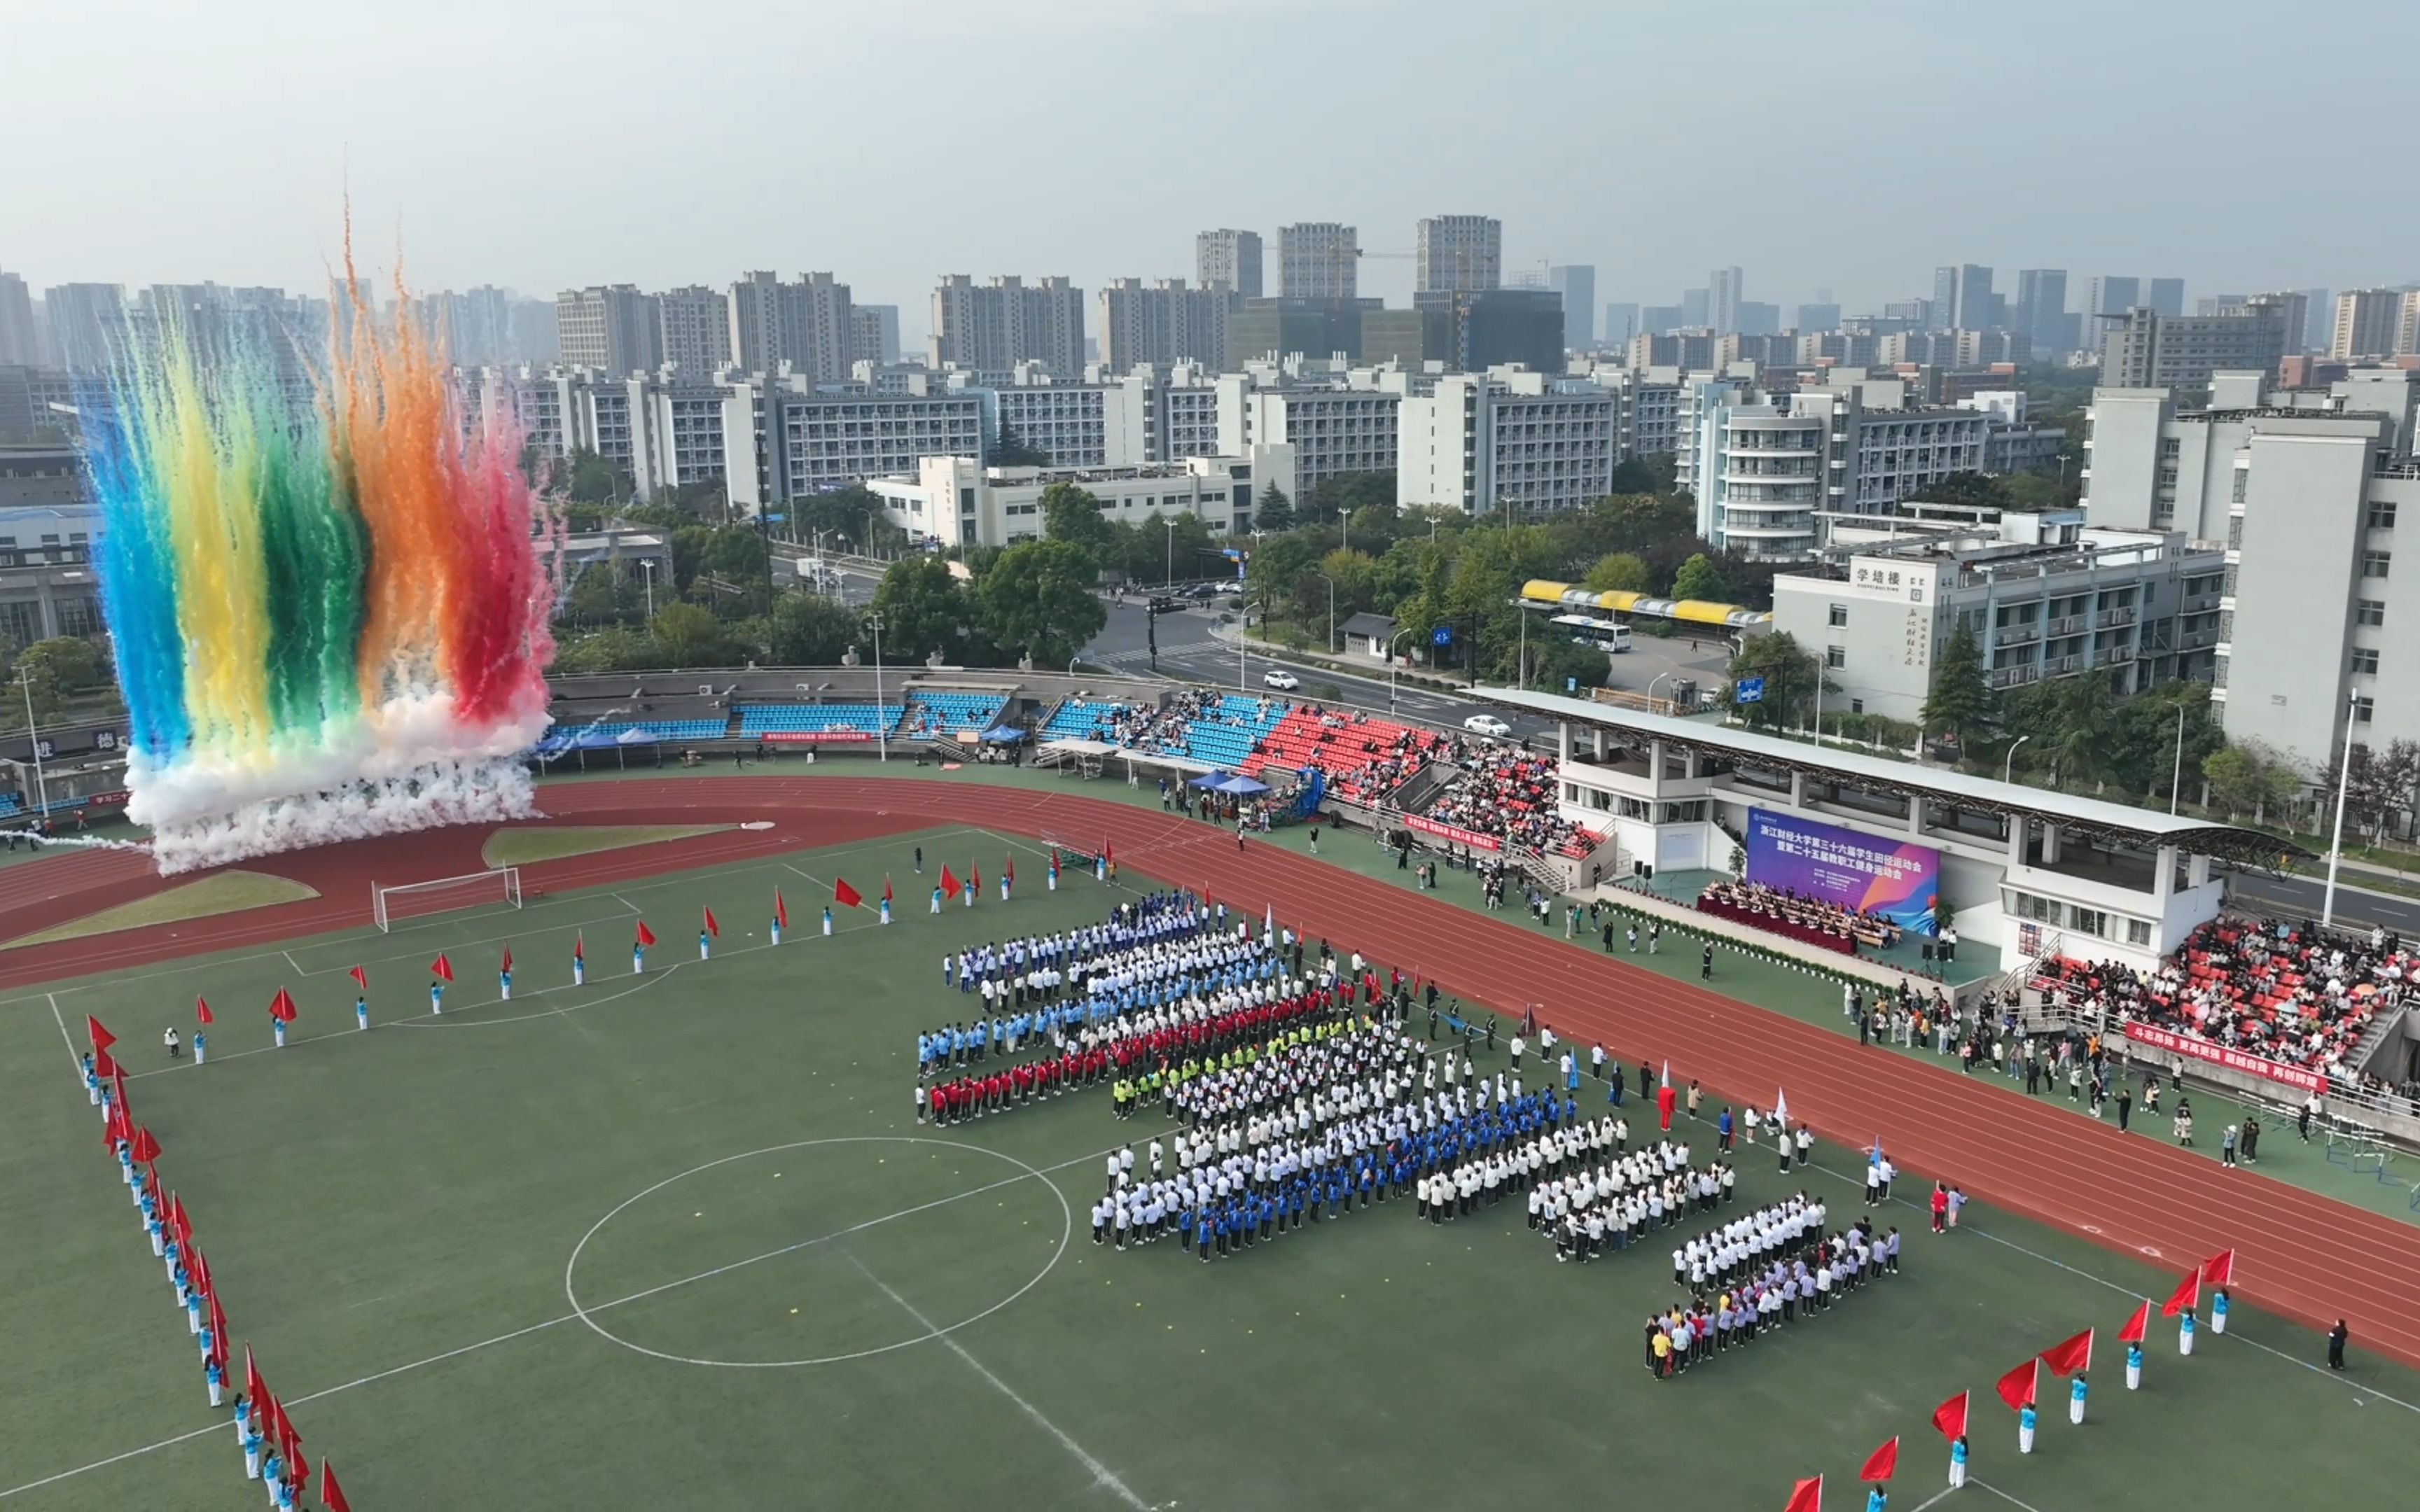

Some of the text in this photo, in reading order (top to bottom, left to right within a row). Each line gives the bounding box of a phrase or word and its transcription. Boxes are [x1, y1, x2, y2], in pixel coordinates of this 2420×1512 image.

[1857, 568, 1900, 585] 学培楼
[97, 732, 115, 749] 德
[95, 792, 132, 804] 学习二十
[1760, 824, 1922, 874] 浙江财经大学第三十六届学生田径运动会
[1776, 840, 1903, 881] 暨第二十五届教职工健身运动会
[2135, 1026, 2318, 1088] 斗志昂扬 更高更强 超越自我 再创辉煌
